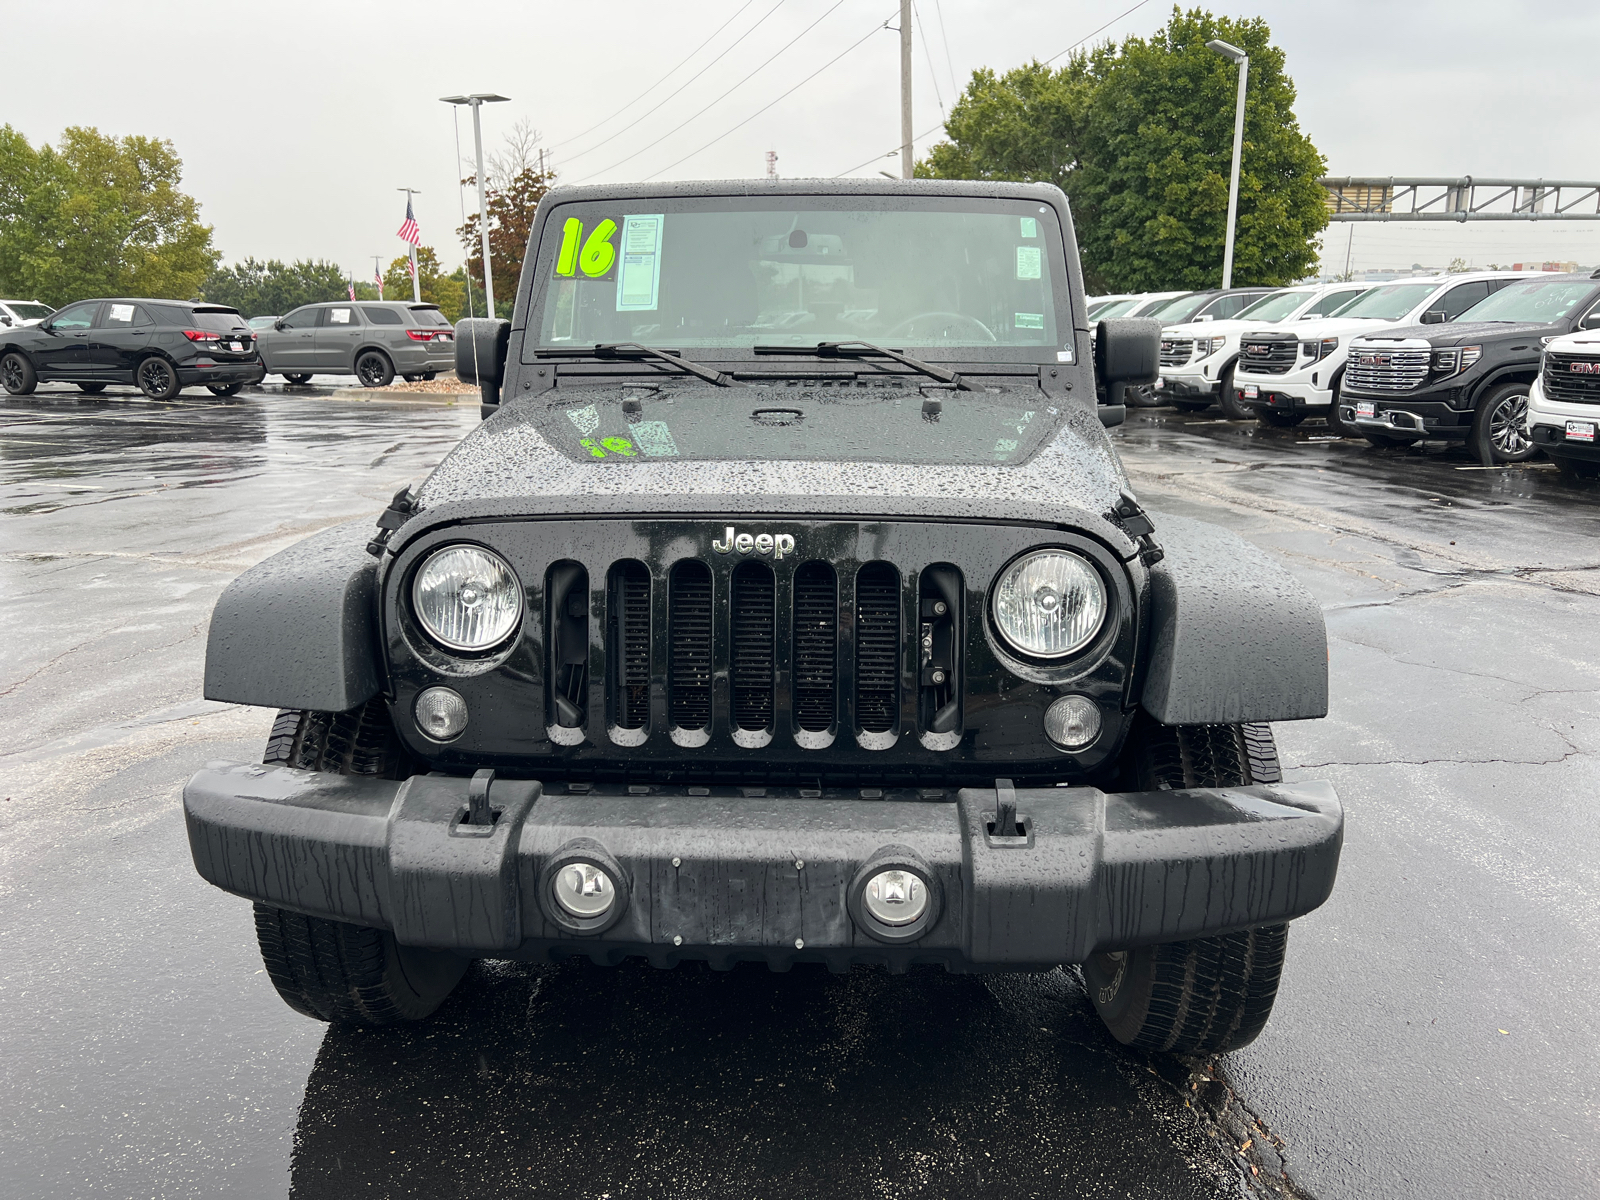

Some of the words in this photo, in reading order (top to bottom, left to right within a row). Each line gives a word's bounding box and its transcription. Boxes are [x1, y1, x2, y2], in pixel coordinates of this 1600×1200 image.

[556, 217, 618, 278] 16
[1360, 356, 1390, 366] GMC
[712, 526, 795, 560] Jeep
